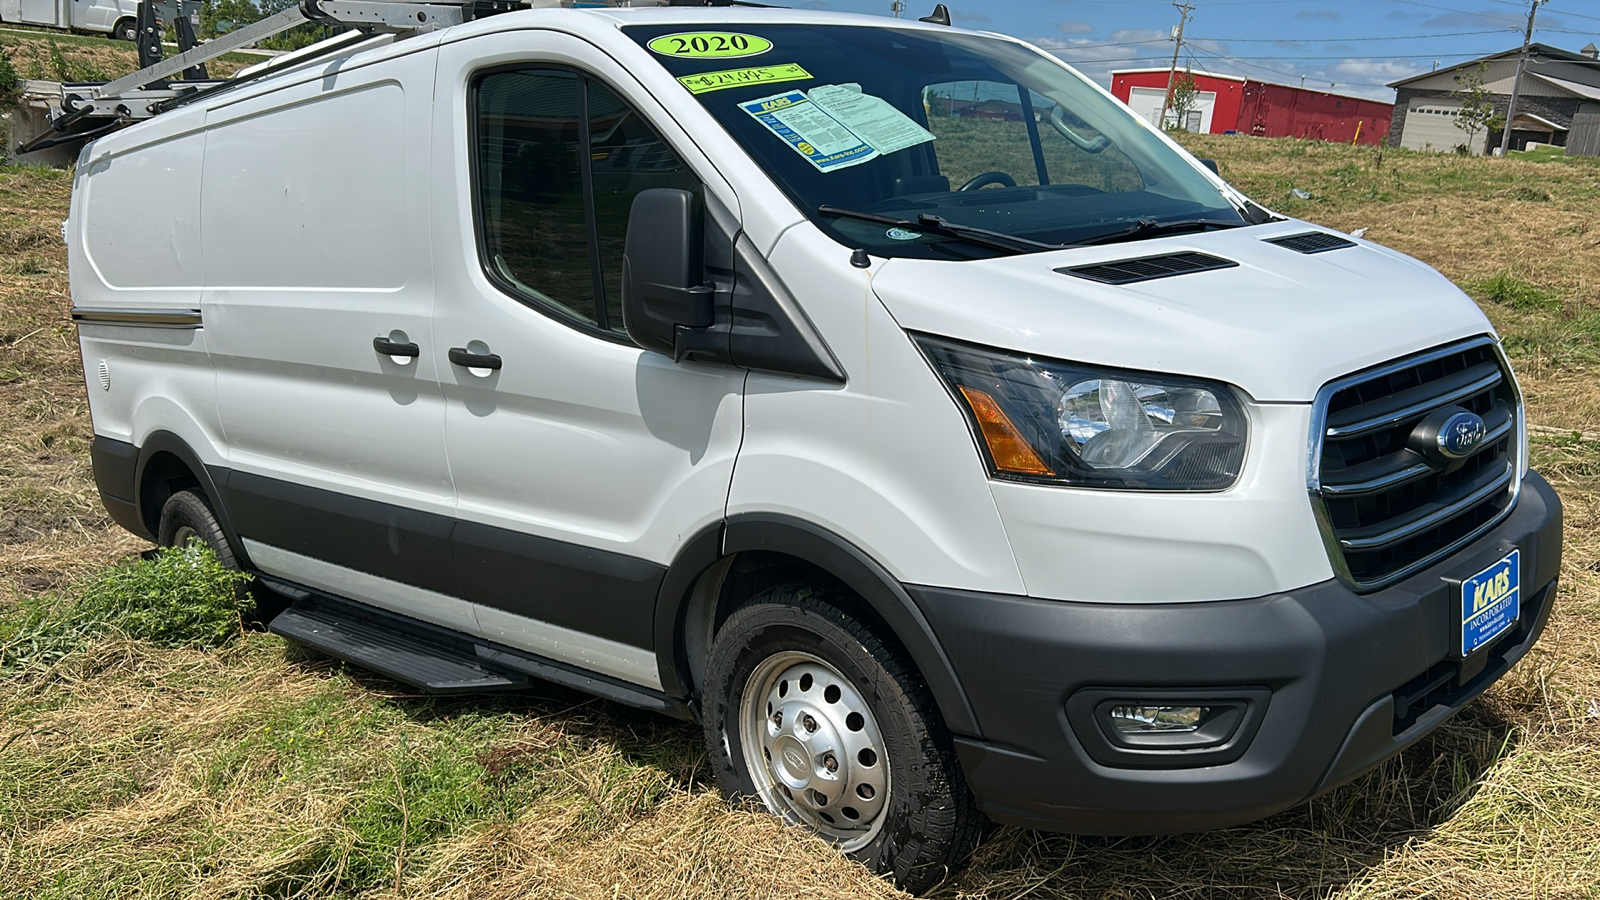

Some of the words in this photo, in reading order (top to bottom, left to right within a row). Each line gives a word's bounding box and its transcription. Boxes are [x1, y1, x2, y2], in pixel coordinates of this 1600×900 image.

[670, 34, 749, 54] 2020
[761, 97, 792, 111] KARS
[1456, 420, 1481, 449] Ford
[1473, 567, 1509, 612] KARS
[1470, 596, 1512, 630] INCORPORATED
